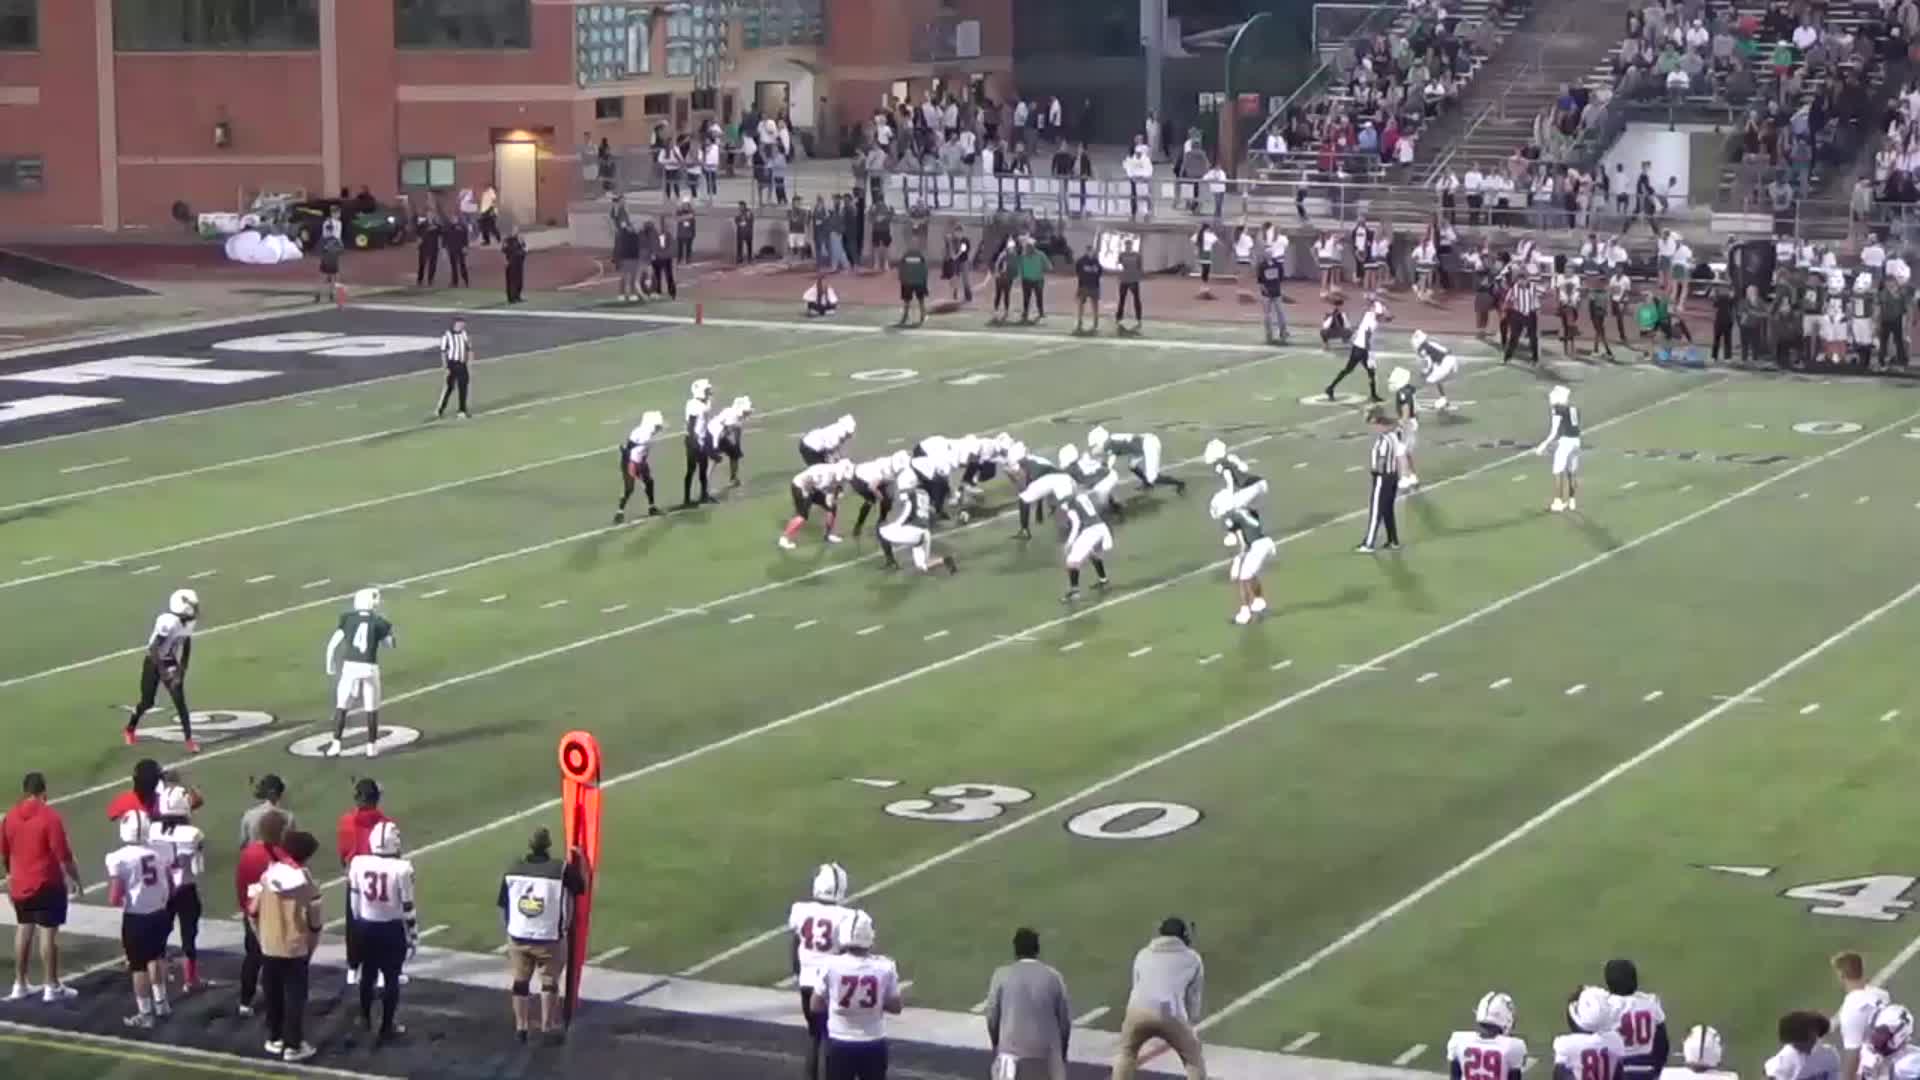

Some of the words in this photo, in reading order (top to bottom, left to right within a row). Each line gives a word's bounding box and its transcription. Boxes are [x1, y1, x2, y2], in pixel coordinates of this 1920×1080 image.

[352, 621, 369, 654] 4
[883, 782, 1202, 839] 30
[141, 854, 158, 887] 5
[363, 870, 389, 903] 31
[801, 916, 834, 952] 43
[838, 975, 878, 1009] 73
